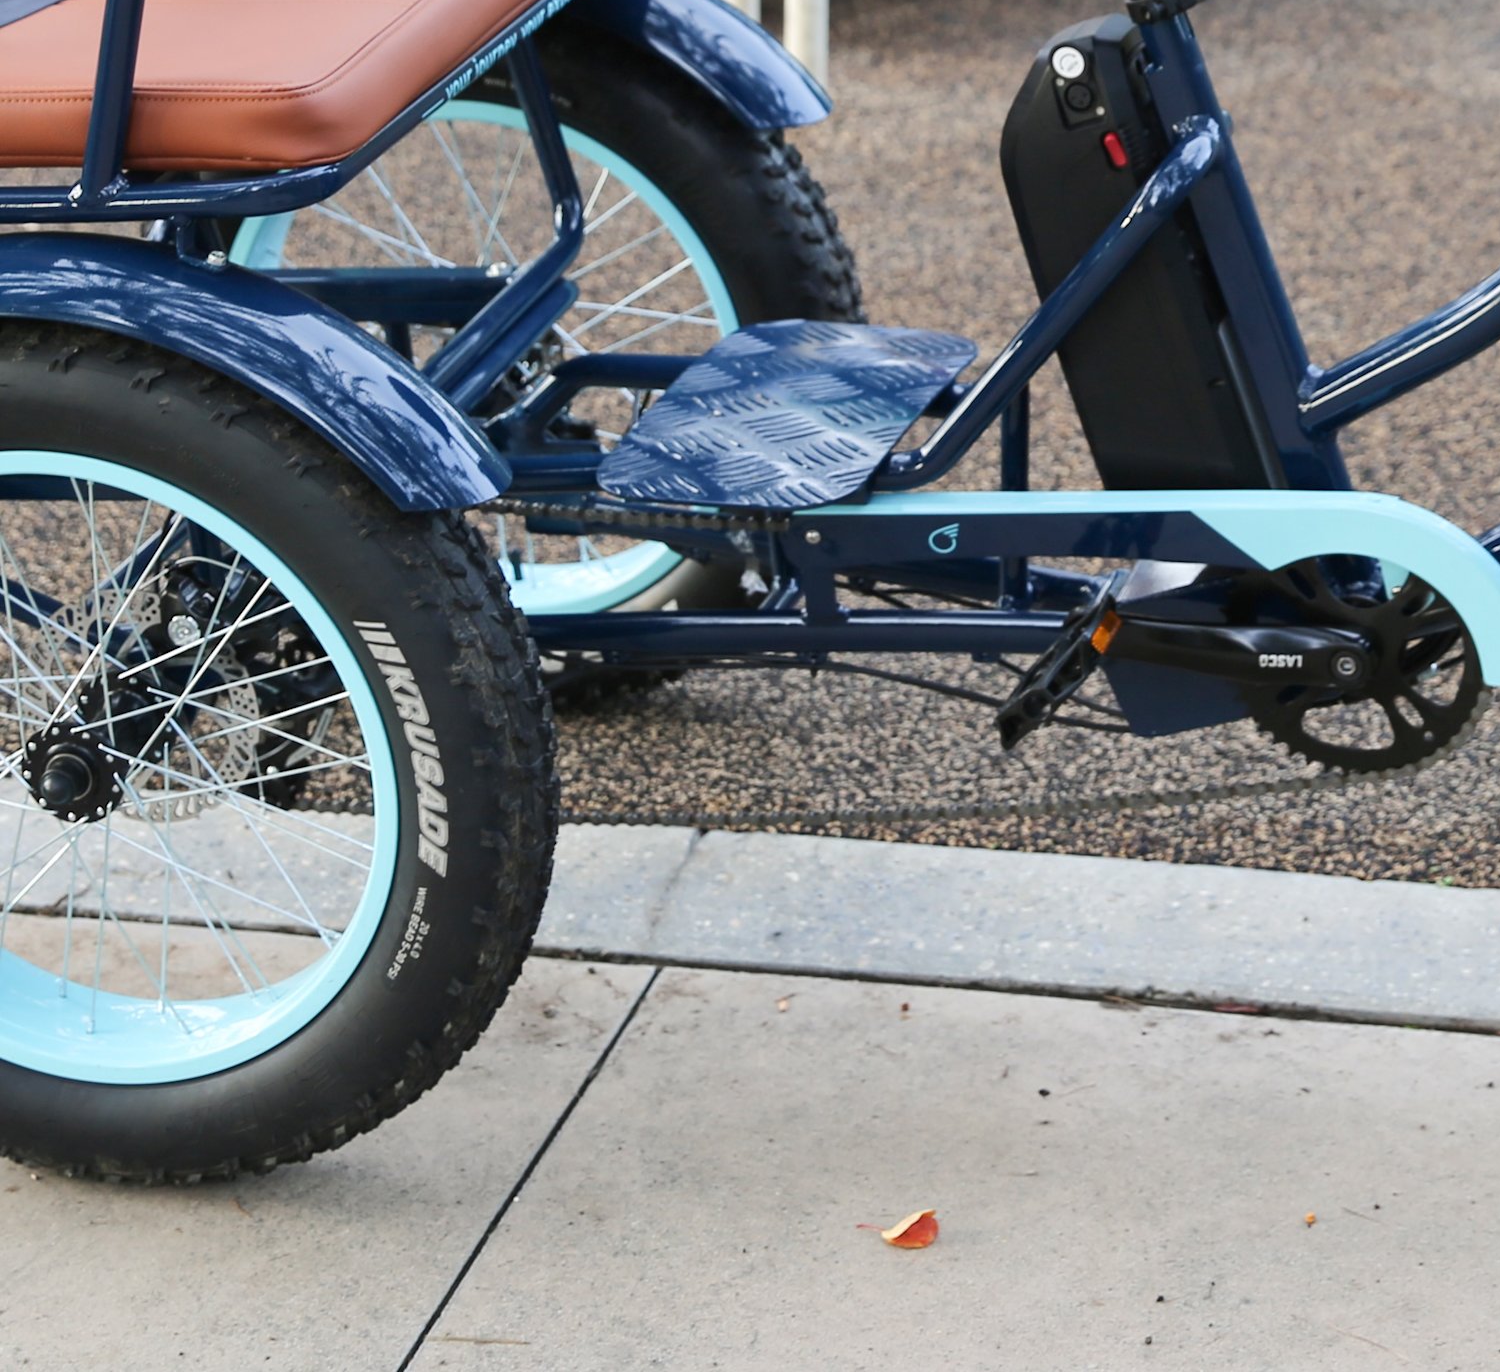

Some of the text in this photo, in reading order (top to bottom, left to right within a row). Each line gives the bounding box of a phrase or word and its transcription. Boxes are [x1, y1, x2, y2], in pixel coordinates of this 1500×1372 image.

[445, 68, 472, 99] your
[520, 8, 545, 39] your
[1258, 654, 1303, 668] LASCO
[377, 662, 449, 877] KRUSADE
[413, 887, 428, 914] WIRE
[404, 913, 421, 942] BEAD
[386, 961, 402, 980] PSI
